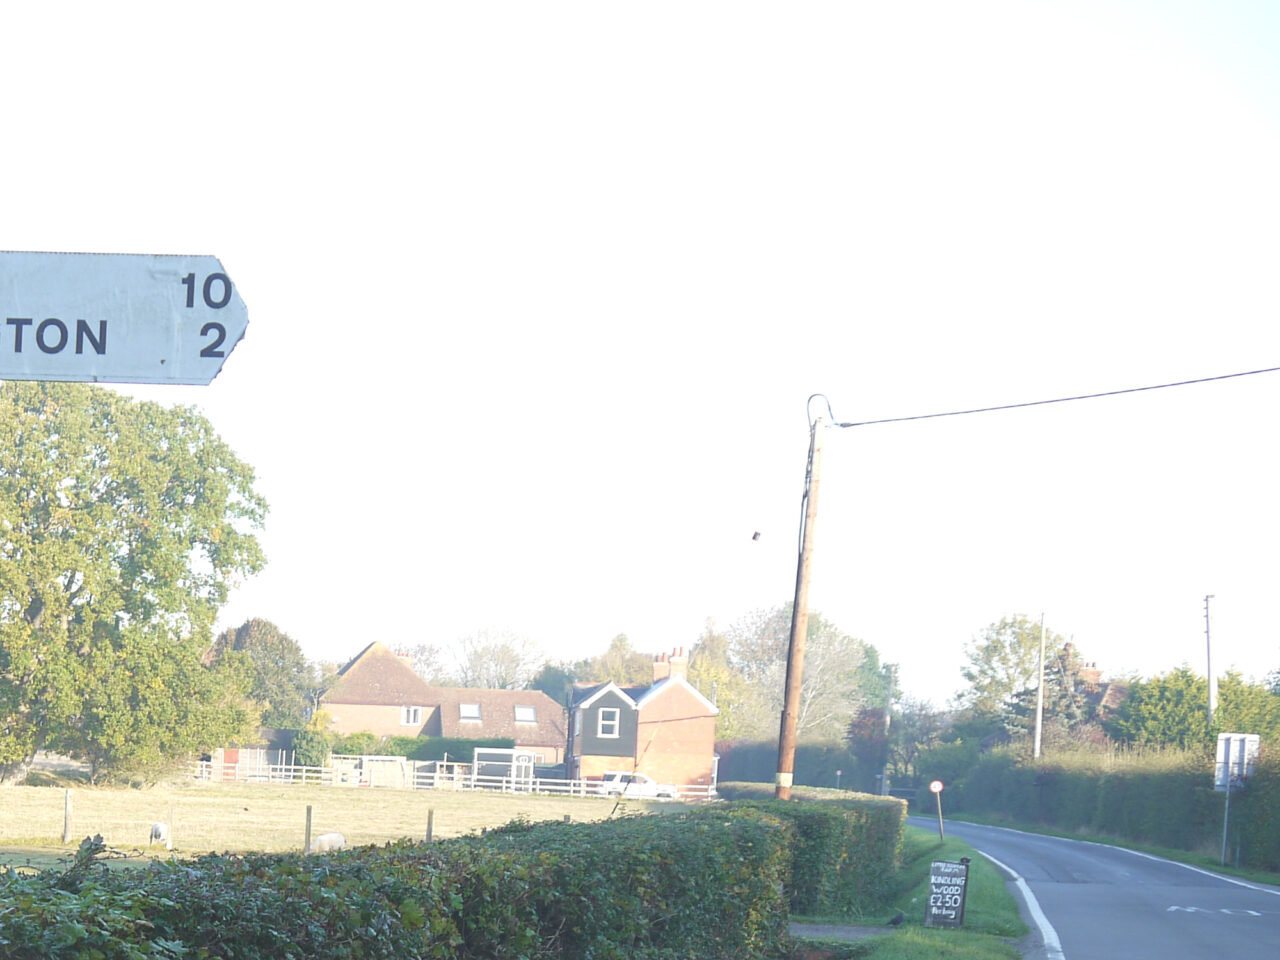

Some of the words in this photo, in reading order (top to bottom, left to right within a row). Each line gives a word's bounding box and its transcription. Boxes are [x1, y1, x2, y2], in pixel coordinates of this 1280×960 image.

[181, 272, 233, 310] 10
[199, 321, 227, 358] 2
[931, 875, 965, 886] KINDLING
[932, 885, 961, 895] WOOD
